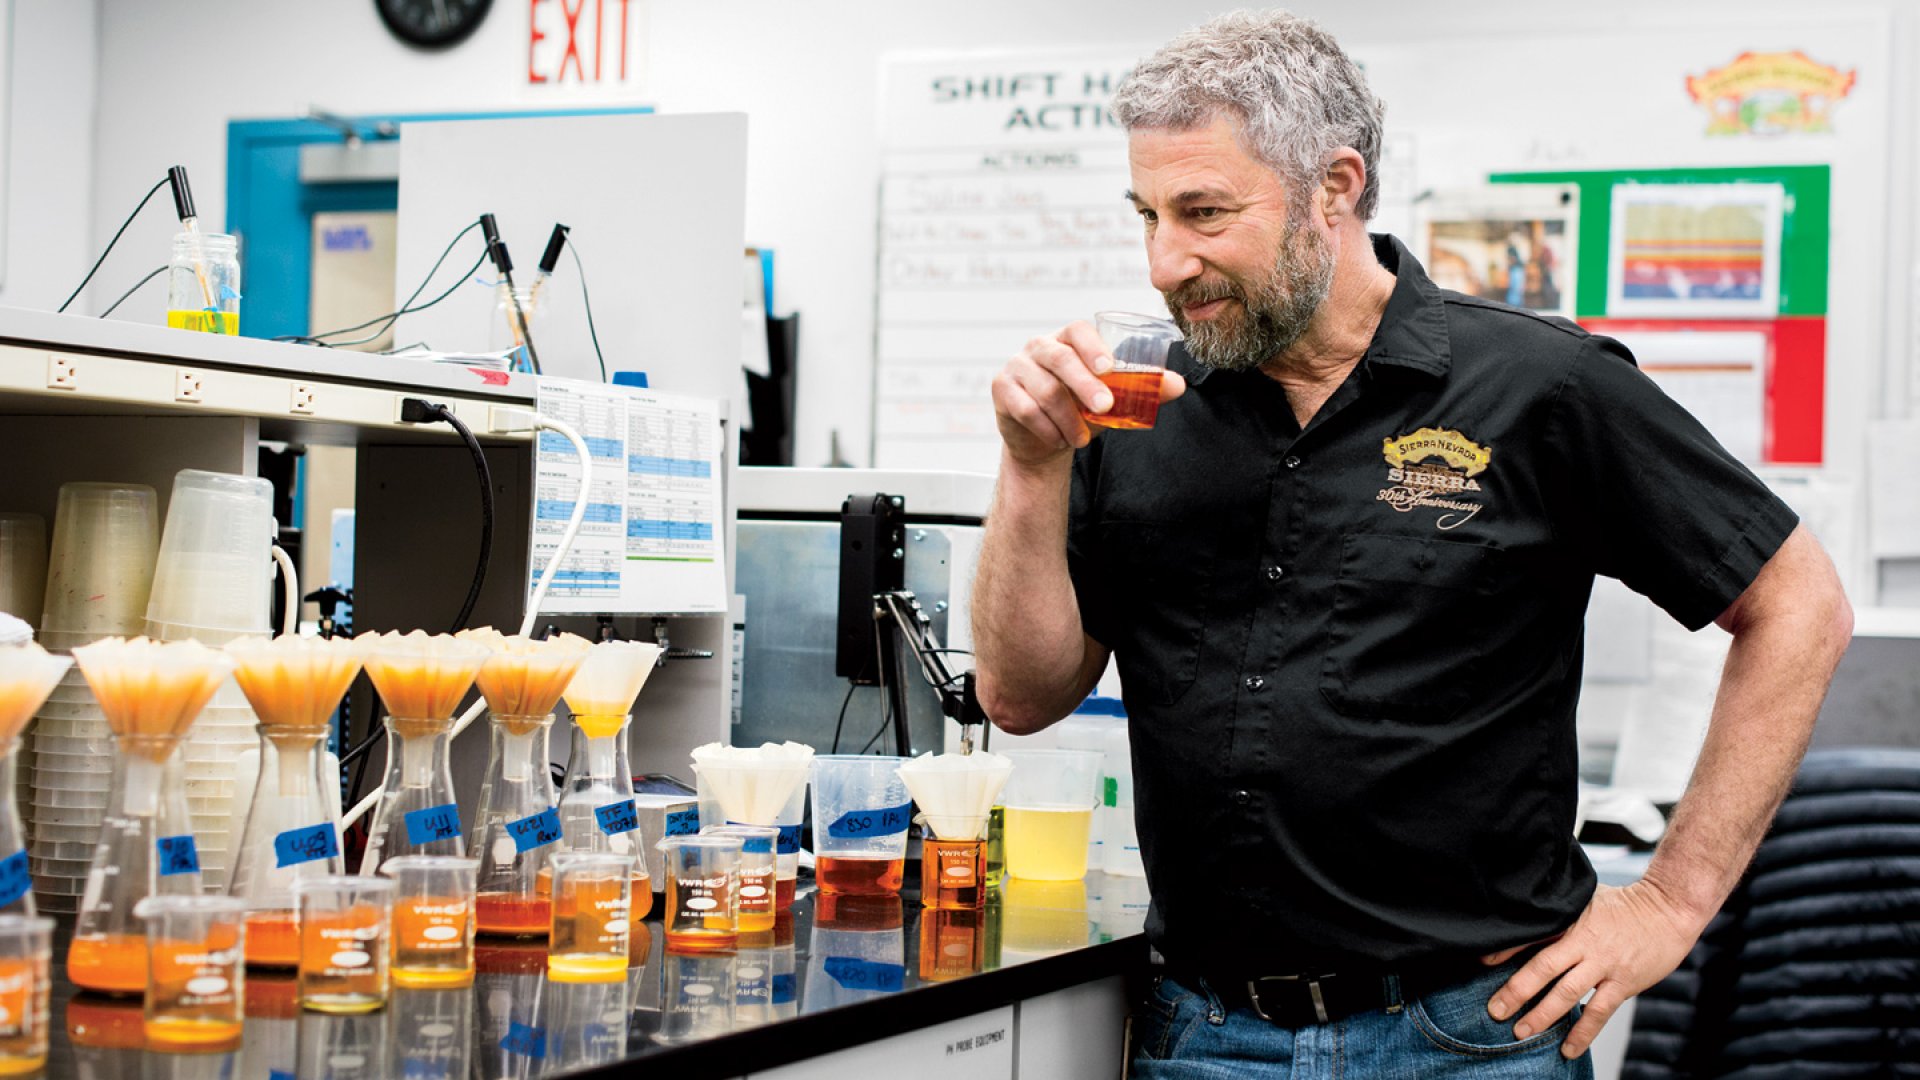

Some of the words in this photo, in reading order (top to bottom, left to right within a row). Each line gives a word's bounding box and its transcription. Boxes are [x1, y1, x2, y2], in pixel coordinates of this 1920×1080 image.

[529, 0, 630, 83] EXIT
[931, 71, 1061, 103] SHIFT
[980, 149, 1081, 170] ACTIONS
[1399, 439, 1436, 456] SIERRA
[1436, 439, 1478, 463] NEVADA
[1387, 467, 1482, 492] SIERRA
[678, 878, 704, 888] VWR
